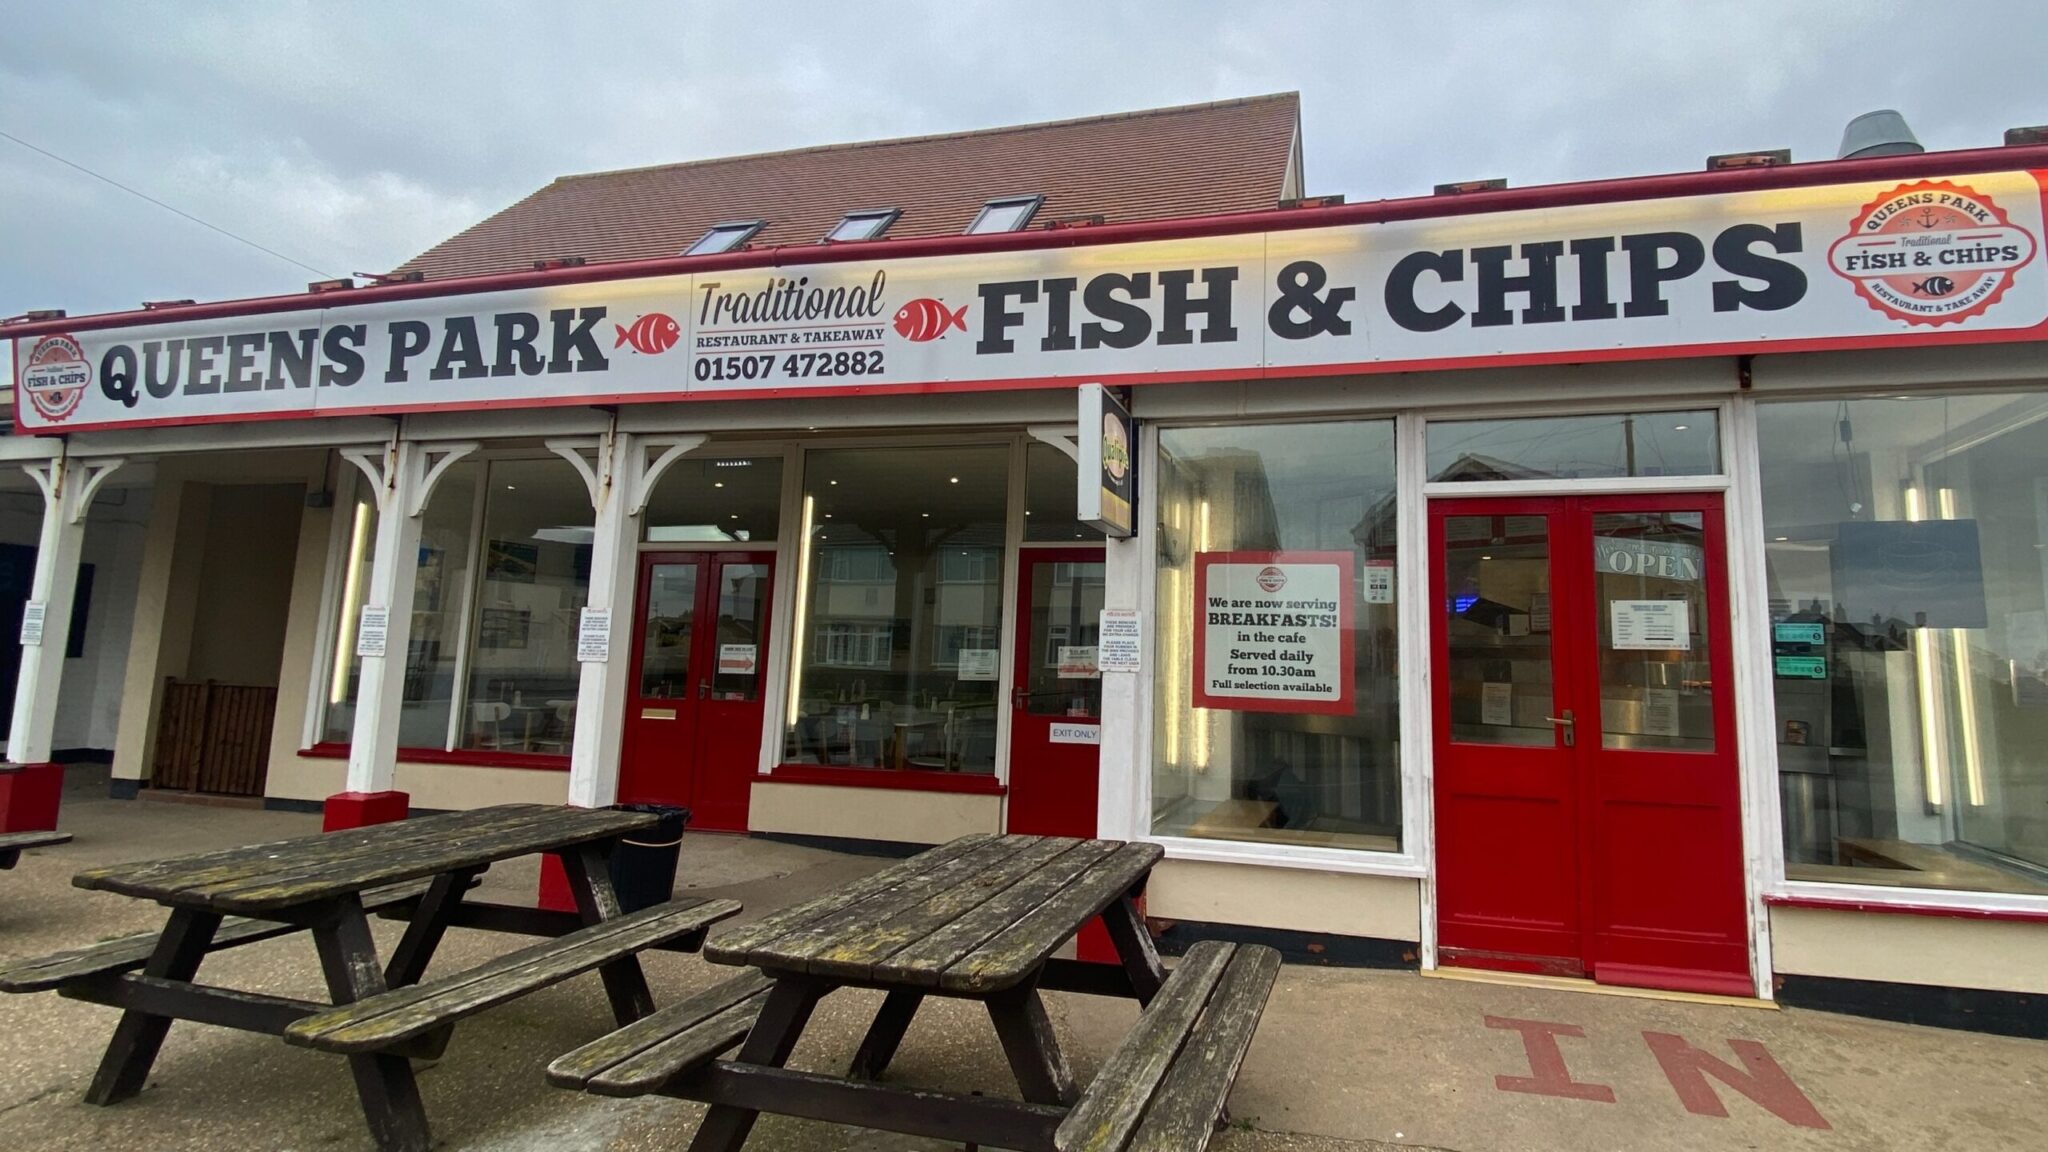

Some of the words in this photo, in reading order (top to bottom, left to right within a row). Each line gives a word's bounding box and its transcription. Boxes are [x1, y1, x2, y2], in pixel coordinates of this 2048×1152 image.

[1867, 193, 1934, 231] QUEENS
[1939, 193, 1990, 222] PARK
[1900, 234, 1952, 248] Traditional
[1913, 251, 1932, 266] &
[976, 266, 1239, 355] FISH
[1267, 260, 1356, 340] &
[1384, 221, 1808, 333] CHIPS
[1871, 283, 1933, 313] RESTAURANT
[1935, 304, 1943, 313] &
[1944, 298, 1973, 311] TAKE
[1973, 276, 1996, 302] AWAY
[699, 269, 886, 326] Traditional
[696, 333, 788, 348] RESTAURANT
[790, 332, 800, 343] &
[803, 328, 885, 343] TAKEAWAY
[100, 324, 367, 409] QUEENS
[384, 306, 609, 384] PARK
[695, 355, 776, 382] 01507
[782, 350, 885, 378] 472882
[1608, 550, 1700, 580] OPEN
[1208, 597, 1228, 608] We
[1231, 599, 1252, 608] are
[1255, 599, 1283, 609] now
[1286, 598, 1337, 612] serving
[1208, 612, 1337, 628] BREAKFASTS!
[1237, 631, 1250, 642] in
[1254, 631, 1275, 643] the
[1277, 632, 1306, 643] cafe
[1230, 649, 1276, 661] Served
[1279, 649, 1314, 664] daily
[1227, 664, 1258, 676] from
[1261, 665, 1316, 677] 10.30am
[1212, 679, 1232, 689] Full
[1234, 680, 1280, 691] selection
[1283, 682, 1332, 693] available
[1053, 728, 1072, 737] EXIT
[1074, 729, 1097, 739] ONLY
[1484, 1014, 1834, 1130] IN
